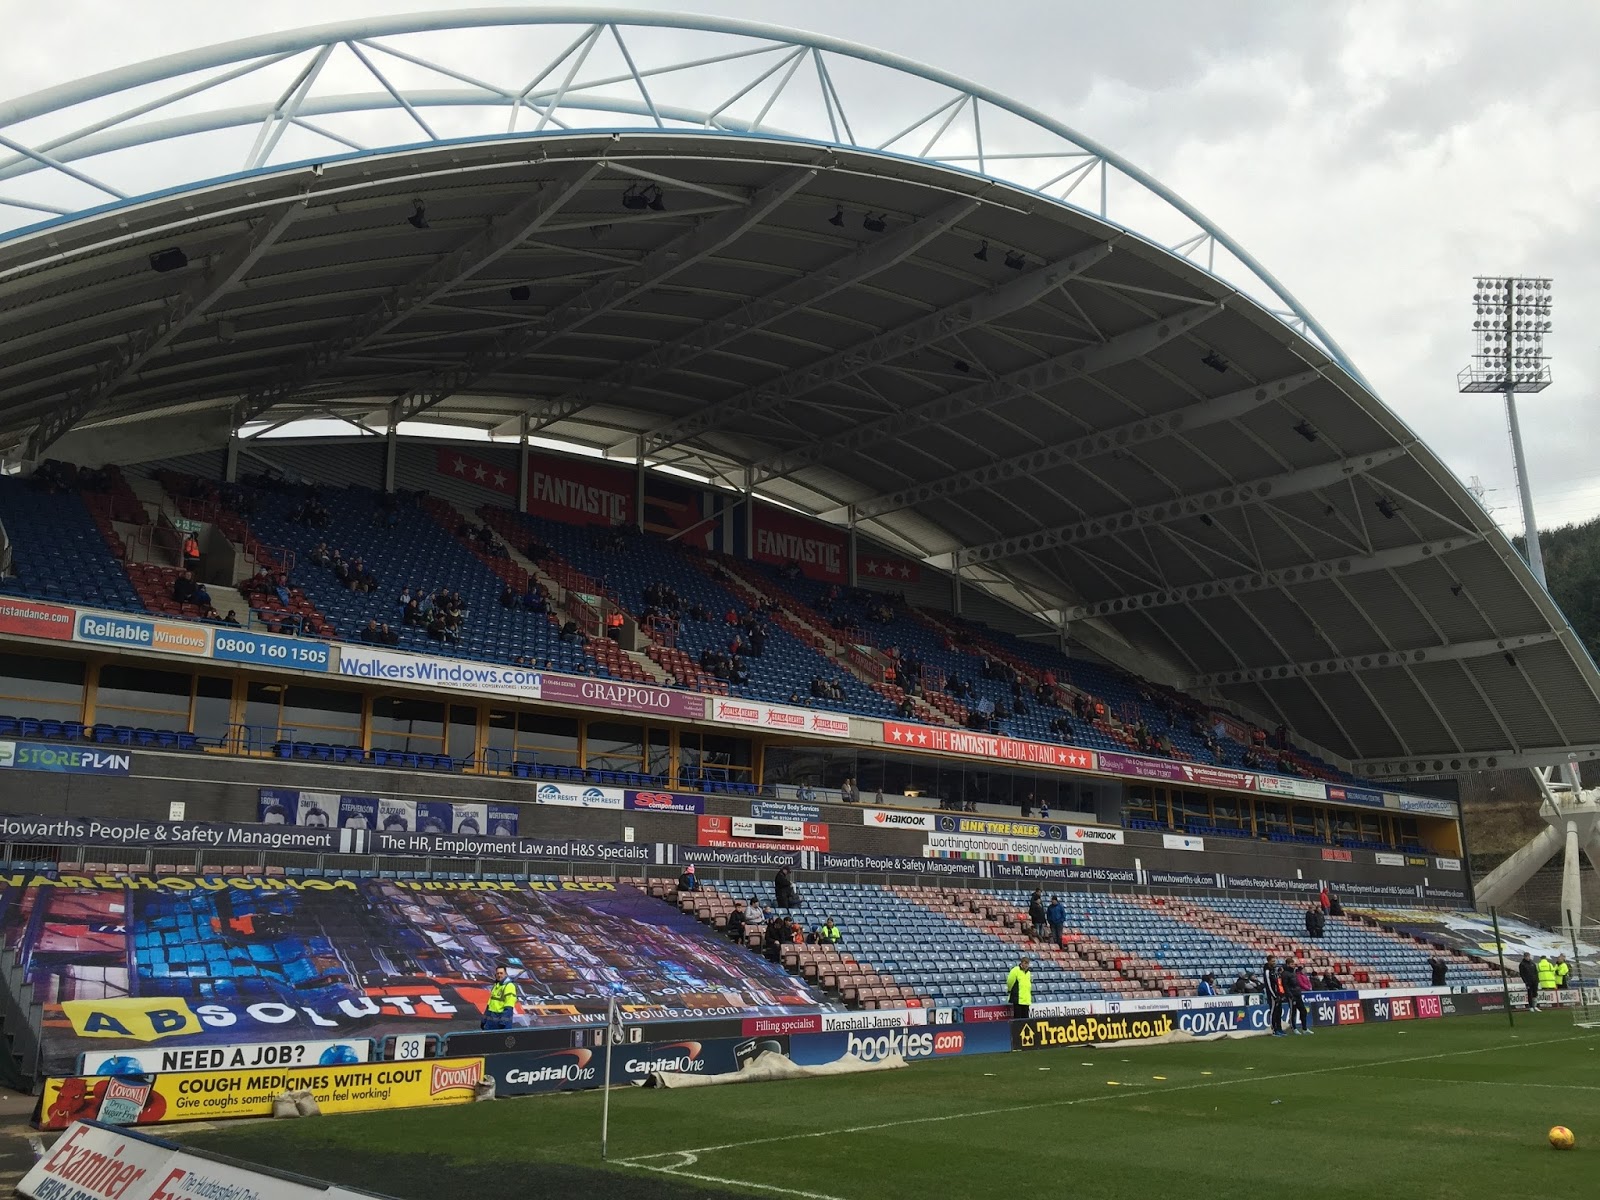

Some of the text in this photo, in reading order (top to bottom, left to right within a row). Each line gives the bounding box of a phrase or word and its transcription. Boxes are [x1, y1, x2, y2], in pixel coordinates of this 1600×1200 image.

[533, 471, 626, 518] FANTASTIC
[757, 528, 840, 567] FANTASTIC
[83, 618, 150, 641] Reliable
[154, 629, 205, 648] Windows
[216, 637, 326, 663] 0800 160 1505
[340, 657, 541, 685] WalkersWindows.com
[581, 682, 670, 708] GRAPPOLO
[930, 730, 1055, 764] THE FANTASTIC MEDIA STAND
[17, 748, 130, 770] STOREPLAN
[300, 800, 318, 808] SMITH
[537, 792, 578, 802] CHEM RESIST
[582, 795, 601, 803] CHEM
[634, 792, 674, 806] SS
[762, 801, 820, 812] Dewsbury Body Services
[341, 803, 374, 814] STEPHENSON
[417, 809, 429, 818] LAW
[684, 803, 695, 811] Ltd
[90, 822, 149, 843] People
[154, 825, 168, 840] &
[171, 824, 224, 846] Safety
[227, 828, 331, 848] Management
[959, 819, 986, 832] LINK
[986, 822, 1011, 834] TYRE
[380, 834, 649, 860] The HR, Employment Law and H&S Specialist
[757, 843, 796, 851] HEPWORTH
[930, 836, 1083, 857] worthingtonbrown design/web/video
[684, 849, 794, 865] www.howarths-uk.com
[823, 856, 976, 875] Howarths People & Safety Management
[997, 864, 1135, 882] The HR, Employment Law and H&S Specialist
[1152, 873, 1214, 885] www.howarths-uk.com
[1229, 877, 1253, 887] Howarths
[1253, 878, 1269, 889] People
[1274, 880, 1288, 890] Safety
[1288, 881, 1318, 891] Management
[1330, 882, 1339, 892] The
[1346, 884, 1372, 894] Employment
[1372, 885, 1381, 895] Law
[1380, 886, 1389, 895] and
[1397, 887, 1415, 896] Specialist
[83, 994, 458, 1036] ABSOLUTE
[973, 1009, 993, 1020] Filling
[1318, 1001, 1361, 1024] sky BET
[1373, 999, 1412, 1020] sky BET
[1419, 997, 1440, 1015] PURE
[755, 1019, 815, 1034] Filling specialist
[825, 1015, 901, 1031] Marshall-James
[938, 1012, 949, 1025] 37
[1179, 1011, 1237, 1033] CORAL
[1037, 1014, 1173, 1045] TradePoint.co.uk
[162, 1045, 306, 1071] NEED A JOB?
[400, 1040, 419, 1059] 38
[178, 1069, 422, 1094] COUGH MEDICINES WITH CLOUT
[434, 1064, 478, 1089] COVONIA
[110, 1082, 146, 1105] COVONIA
[176, 1087, 391, 1109] Give coughs can feel working!
[102, 1106, 138, 1121] Sugar Free
[43, 1125, 147, 1200] Examiner
[32, 1176, 67, 1200] NEWS
